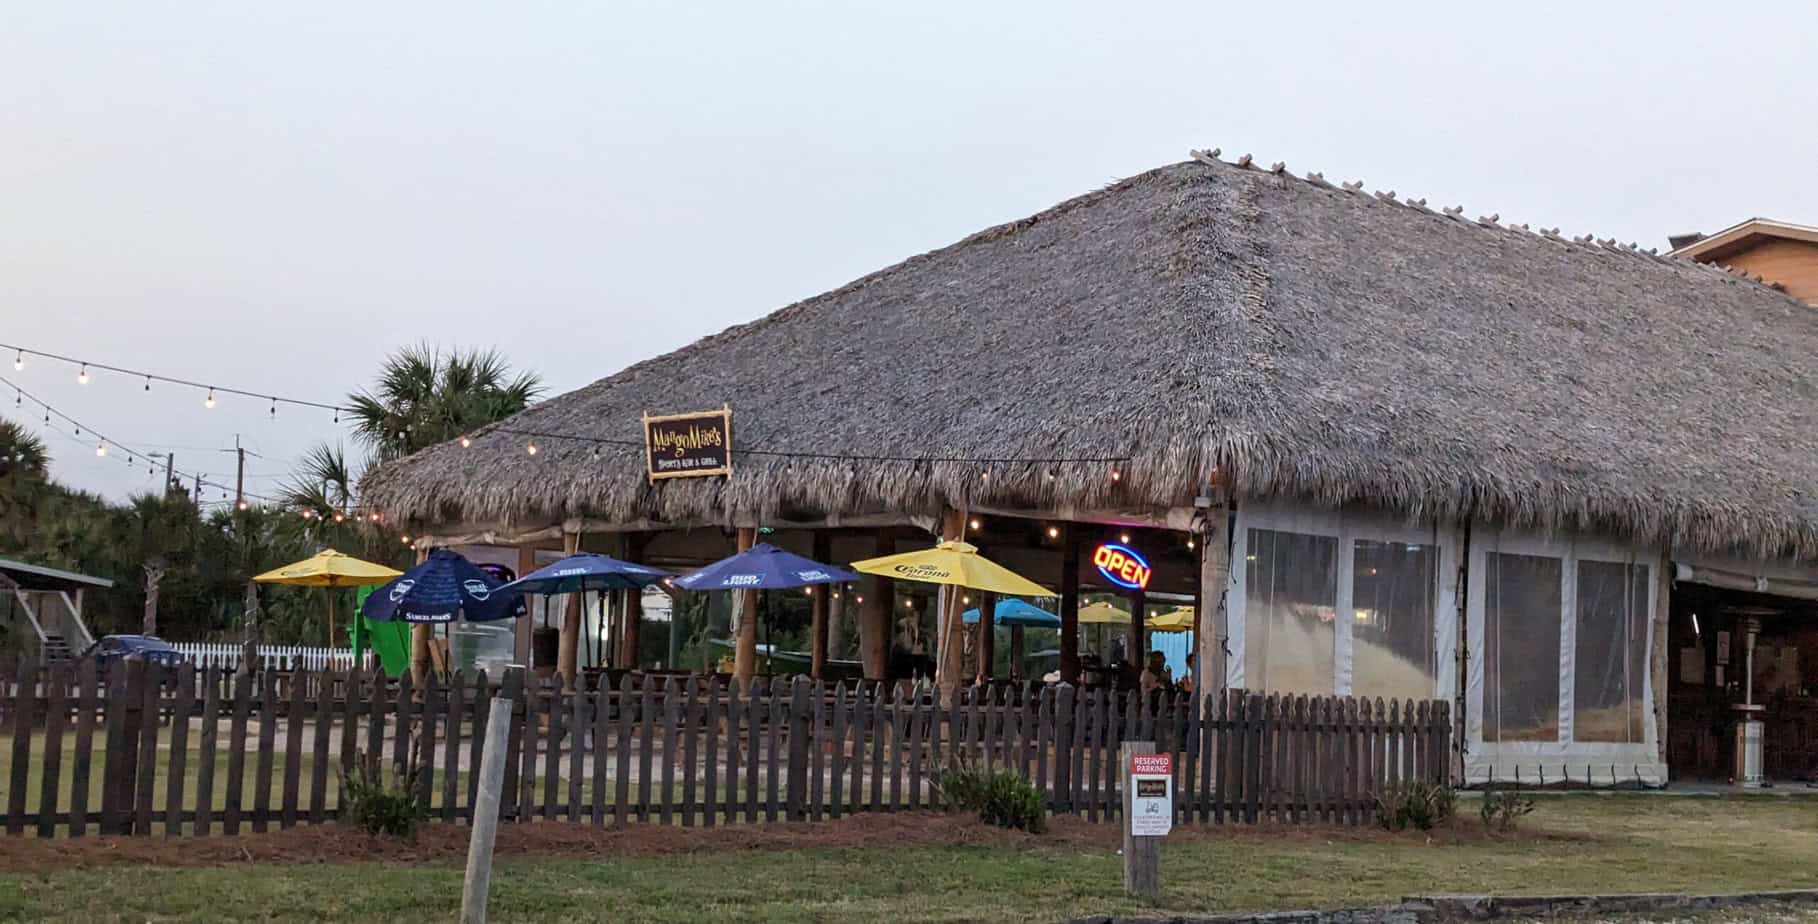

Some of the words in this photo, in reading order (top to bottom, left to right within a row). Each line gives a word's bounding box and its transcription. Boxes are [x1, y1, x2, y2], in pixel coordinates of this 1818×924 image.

[1094, 545, 1151, 589] OPEN
[1134, 757, 1169, 765] RESERVED
[1136, 765, 1167, 773] PARKING
